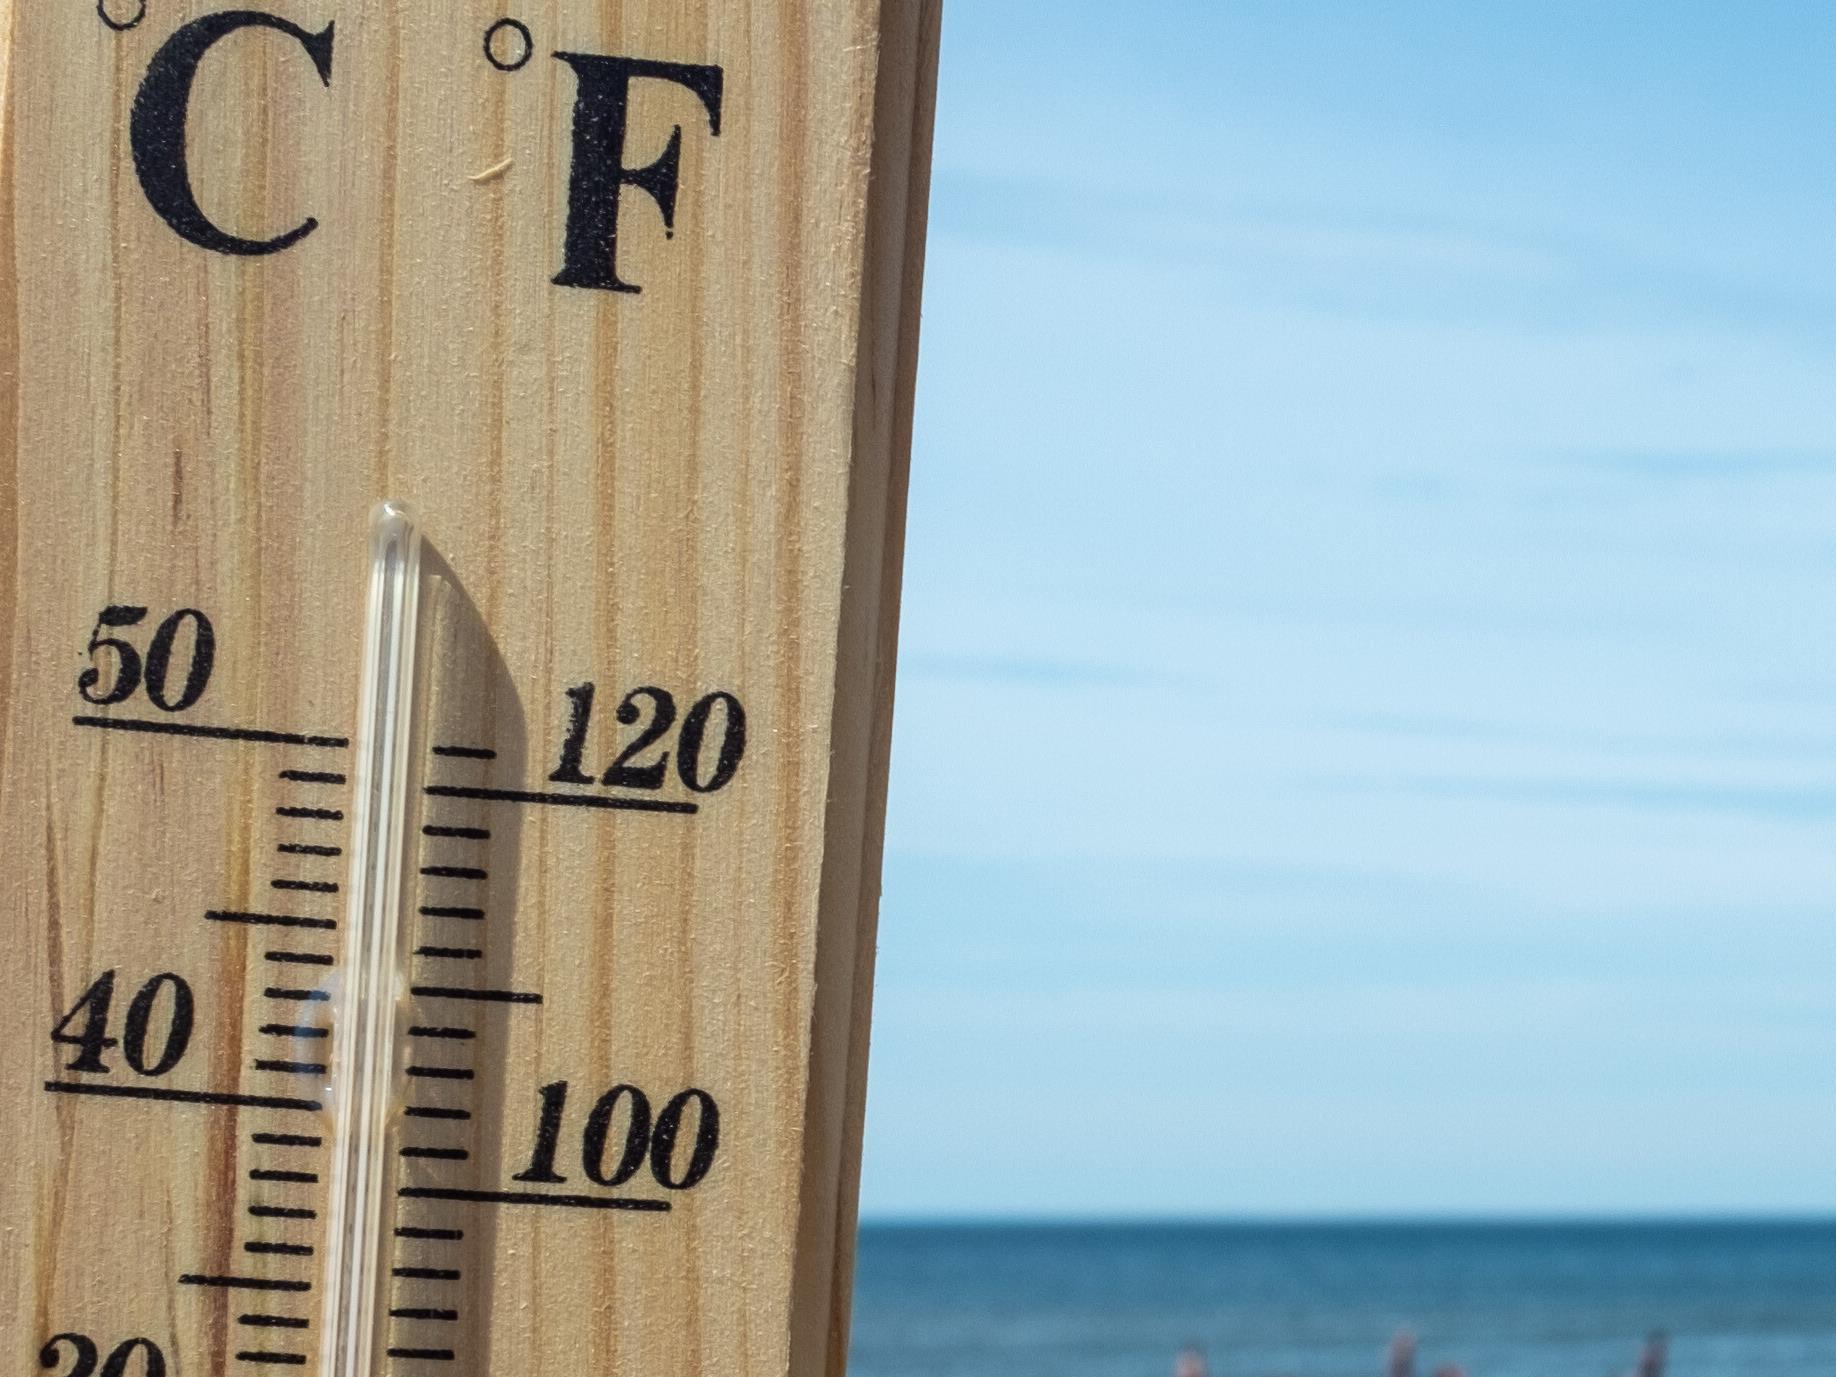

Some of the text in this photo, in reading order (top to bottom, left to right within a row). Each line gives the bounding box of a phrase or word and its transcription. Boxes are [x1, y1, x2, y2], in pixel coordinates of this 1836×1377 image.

[77, 606, 216, 712] 50
[548, 681, 747, 793] 120
[50, 970, 194, 1076] 40
[512, 1079, 720, 1191] 100
